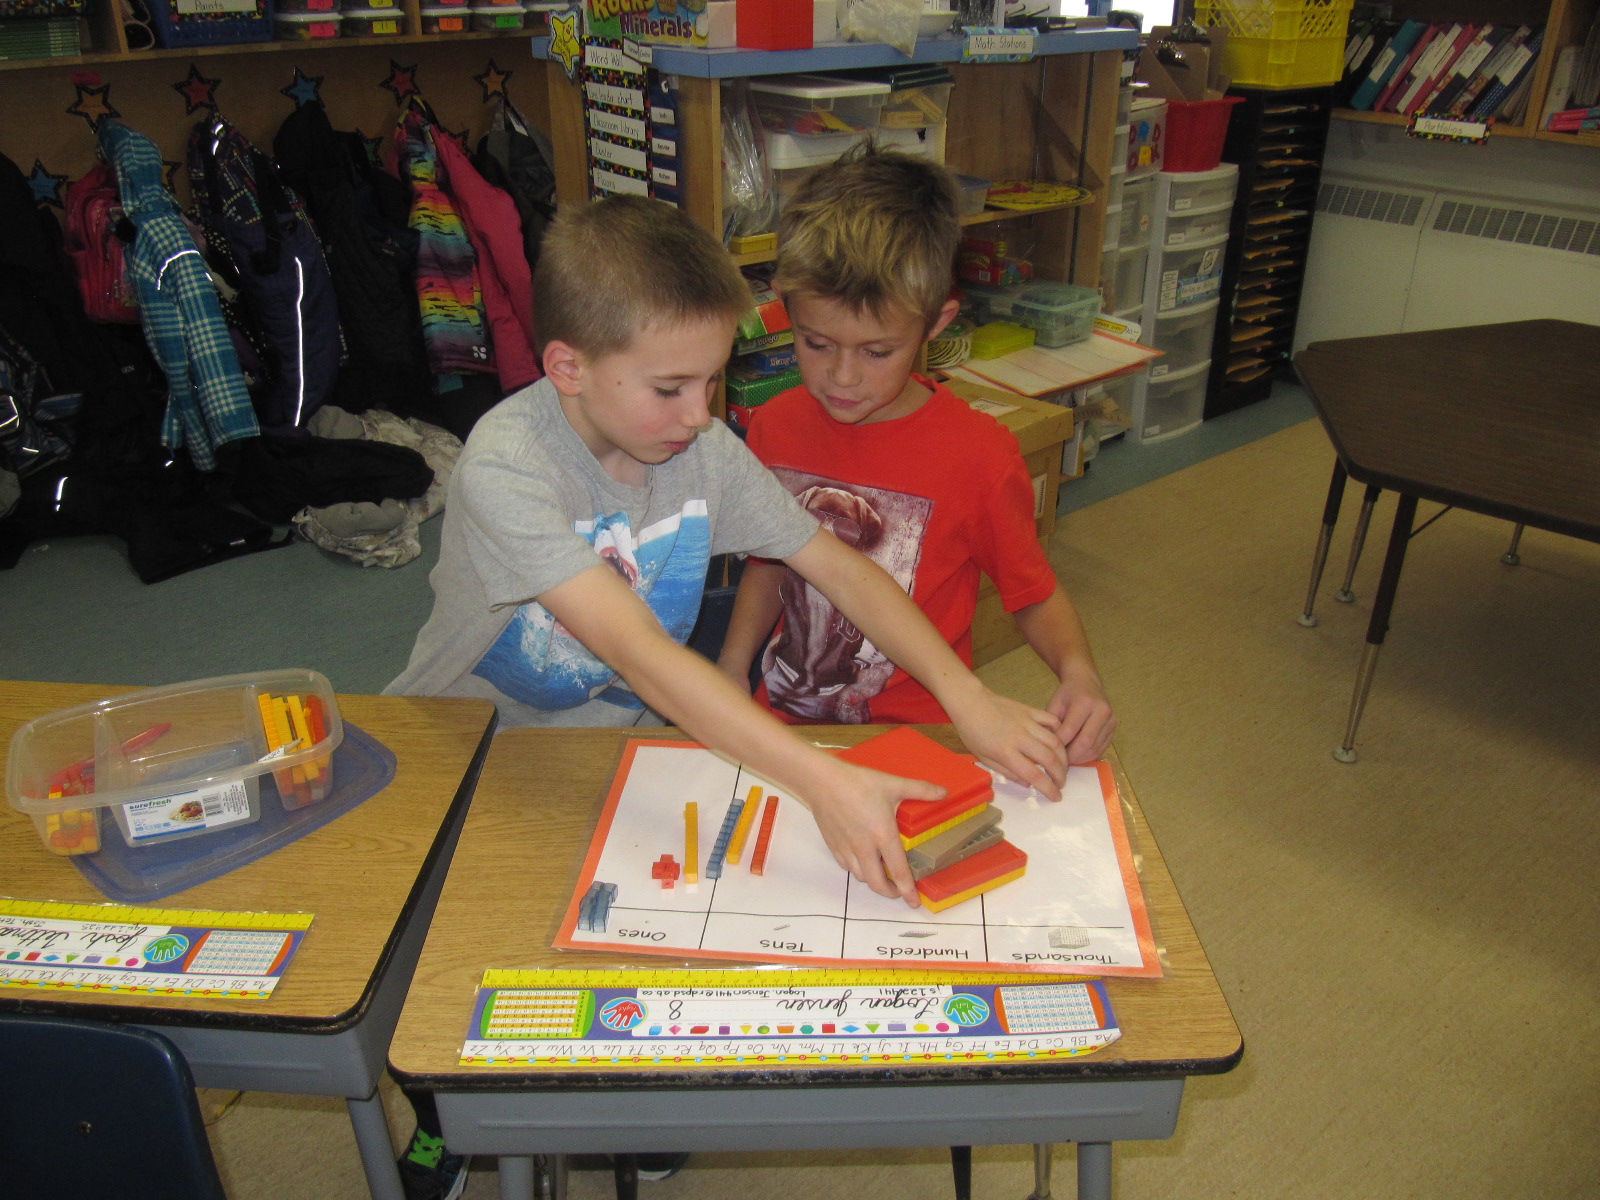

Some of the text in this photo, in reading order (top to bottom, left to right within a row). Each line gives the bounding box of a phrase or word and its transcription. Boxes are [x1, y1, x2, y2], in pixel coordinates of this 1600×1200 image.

[620, 14, 693, 38] Minerals
[974, 35, 1027, 49] Math Stations
[590, 49, 609, 65] Word
[129, 798, 172, 810] surefresh
[80, 926, 148, 953] Josh
[618, 929, 667, 942] Ones
[759, 939, 813, 953] Tens
[876, 947, 969, 960] Hundreds
[1011, 953, 1120, 965] Thousands
[668, 989, 940, 1021] Logan Jensen 8
[470, 1033, 1112, 1056] Aa Bb Cc Dd Ee Ff Gg Hh Ii Jj Kk Ll Mm Nn Oo Pp Qq Rr Ss Tt Uu Vv Ww Xx Yy Zz
